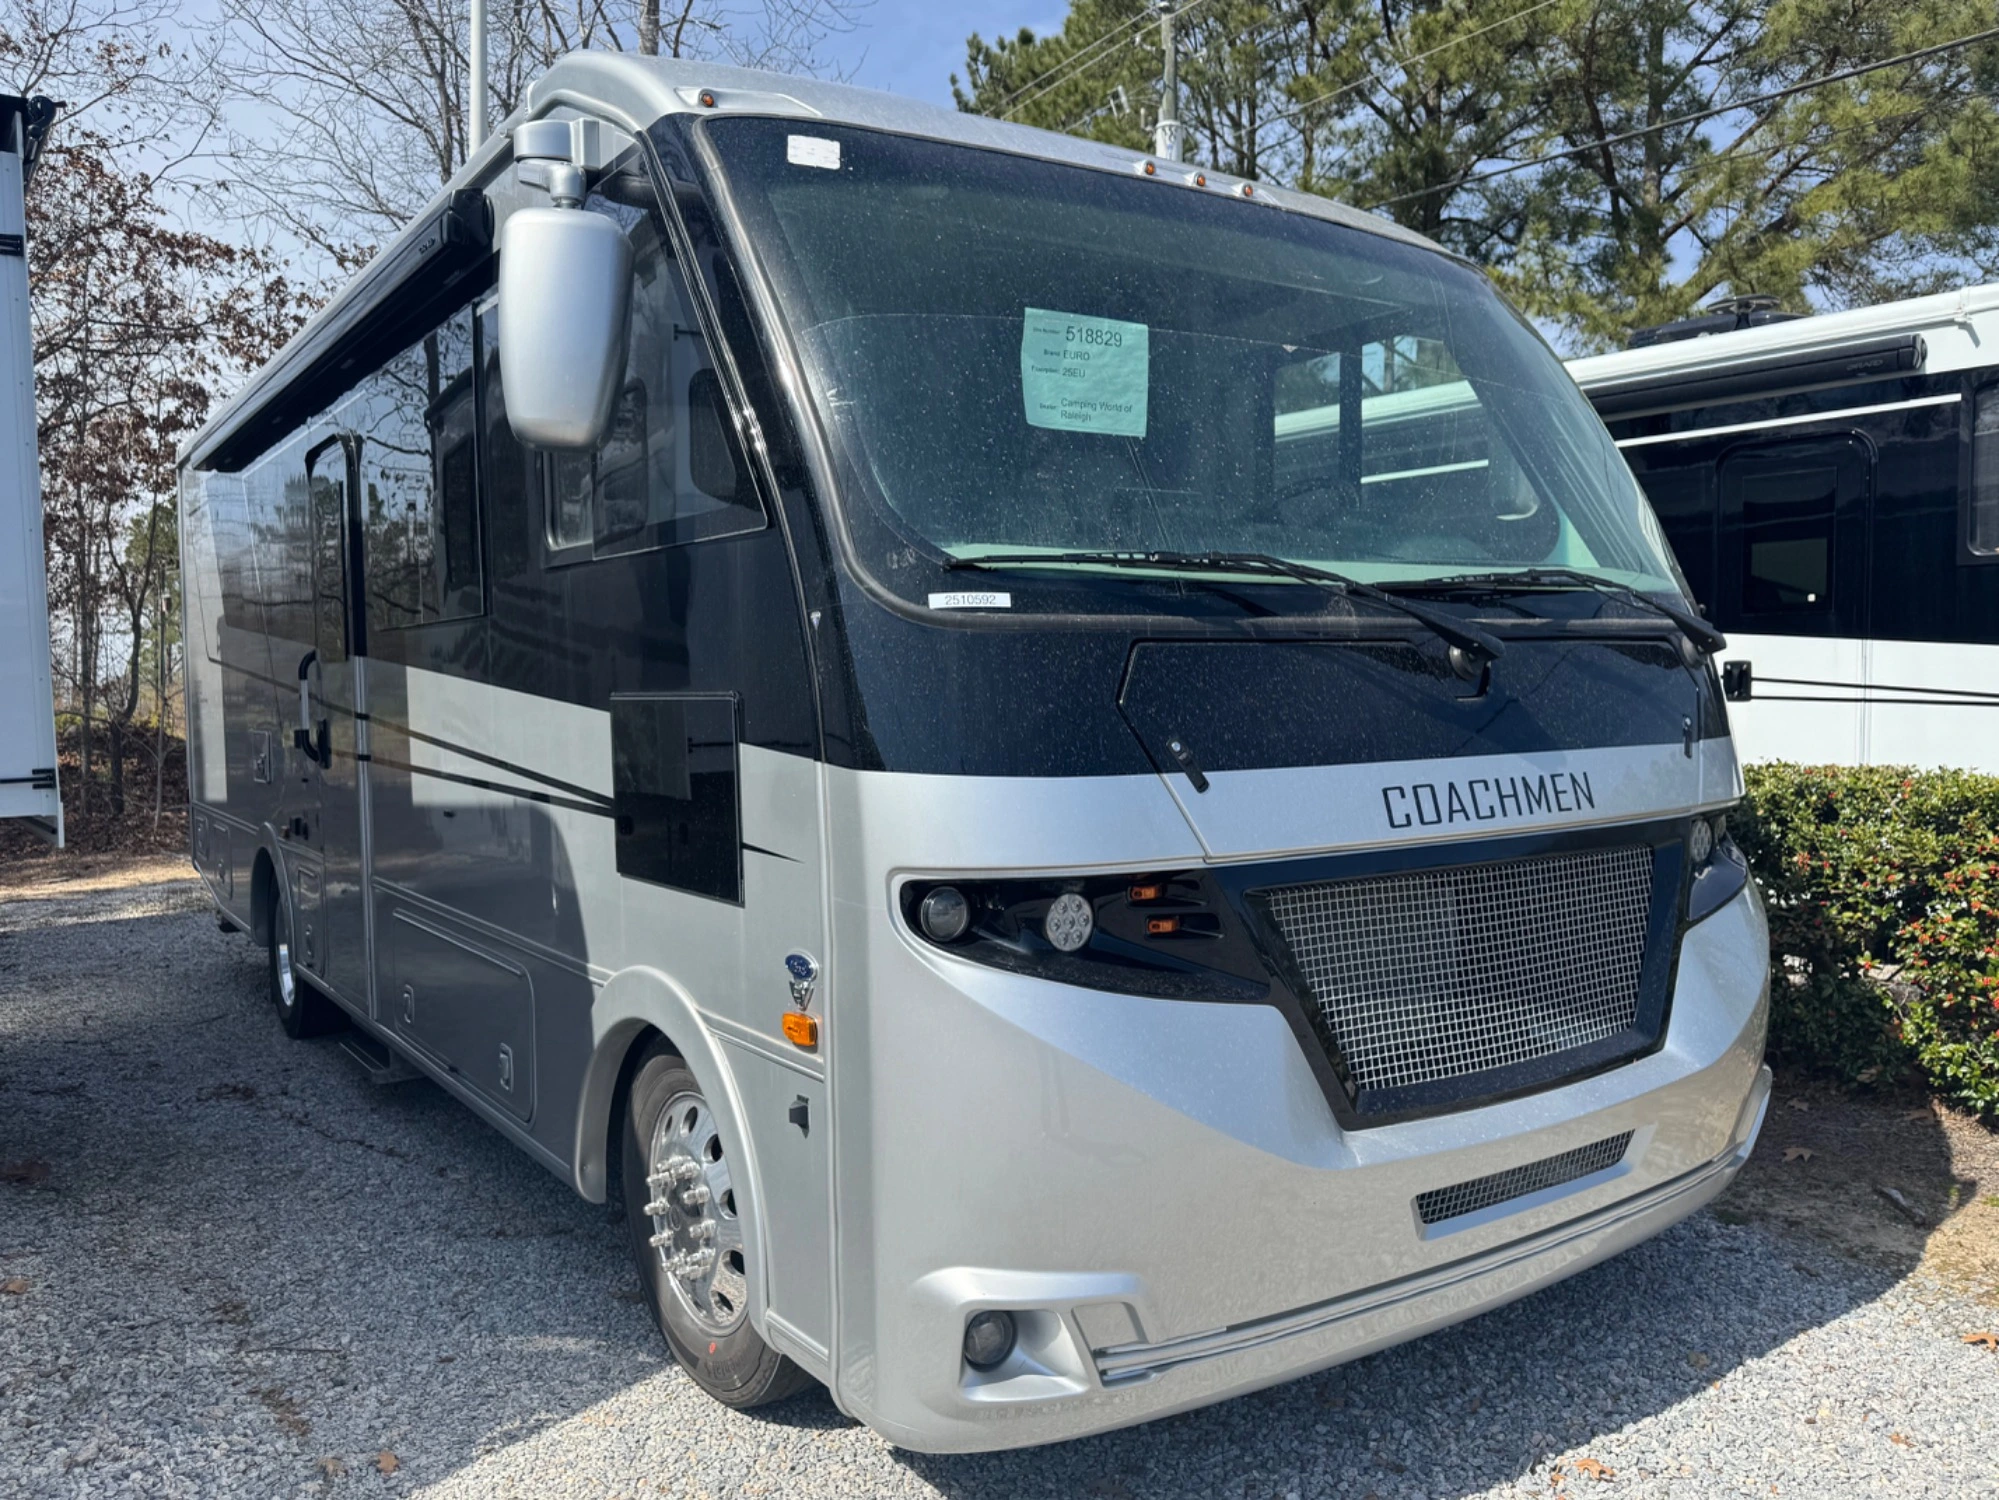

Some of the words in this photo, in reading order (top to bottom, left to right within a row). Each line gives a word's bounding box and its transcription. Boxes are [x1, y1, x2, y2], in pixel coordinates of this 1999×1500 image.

[1065, 325, 1122, 348] 518829
[1063, 349, 1091, 361] EURO
[1062, 366, 1086, 378] 25EU
[1060, 397, 1097, 412] Camping
[1098, 400, 1122, 413] World
[1123, 404, 1134, 413] of
[1060, 409, 1092, 422] Raleigh
[945, 594, 996, 605] 2510592
[1381, 771, 1596, 829] COACHMEN
